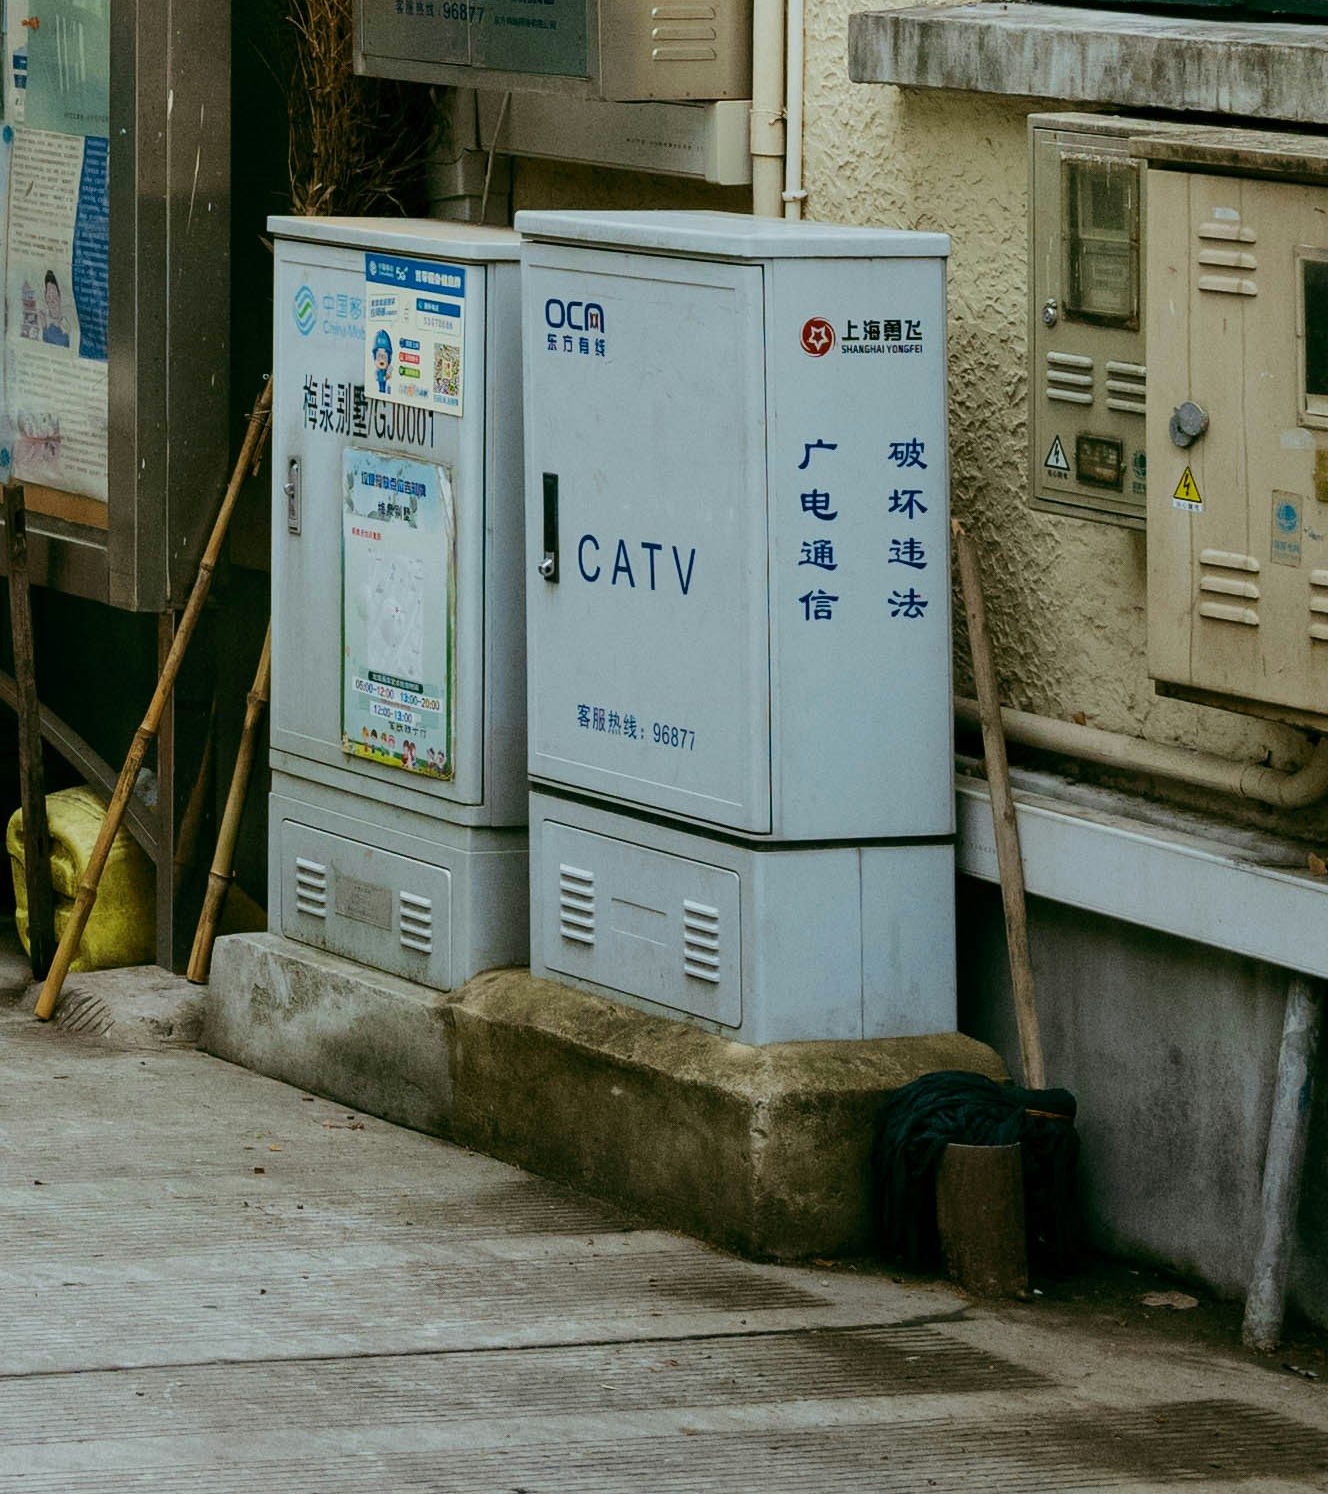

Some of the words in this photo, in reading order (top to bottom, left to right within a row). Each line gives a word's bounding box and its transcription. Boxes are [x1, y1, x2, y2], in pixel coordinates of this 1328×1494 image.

[443, 2, 484, 24] 96877
[323, 294, 365, 320] 中国移
[841, 319, 922, 341] 上海勇飞
[547, 334, 605, 357] 东方有线
[841, 344, 884, 355] SHANGHAI
[886, 344, 923, 354] YONGFEI
[798, 438, 839, 621] 广电通信
[888, 437, 928, 619] 破坏违法
[577, 534, 696, 595] CATV
[653, 722, 696, 751] 96877
